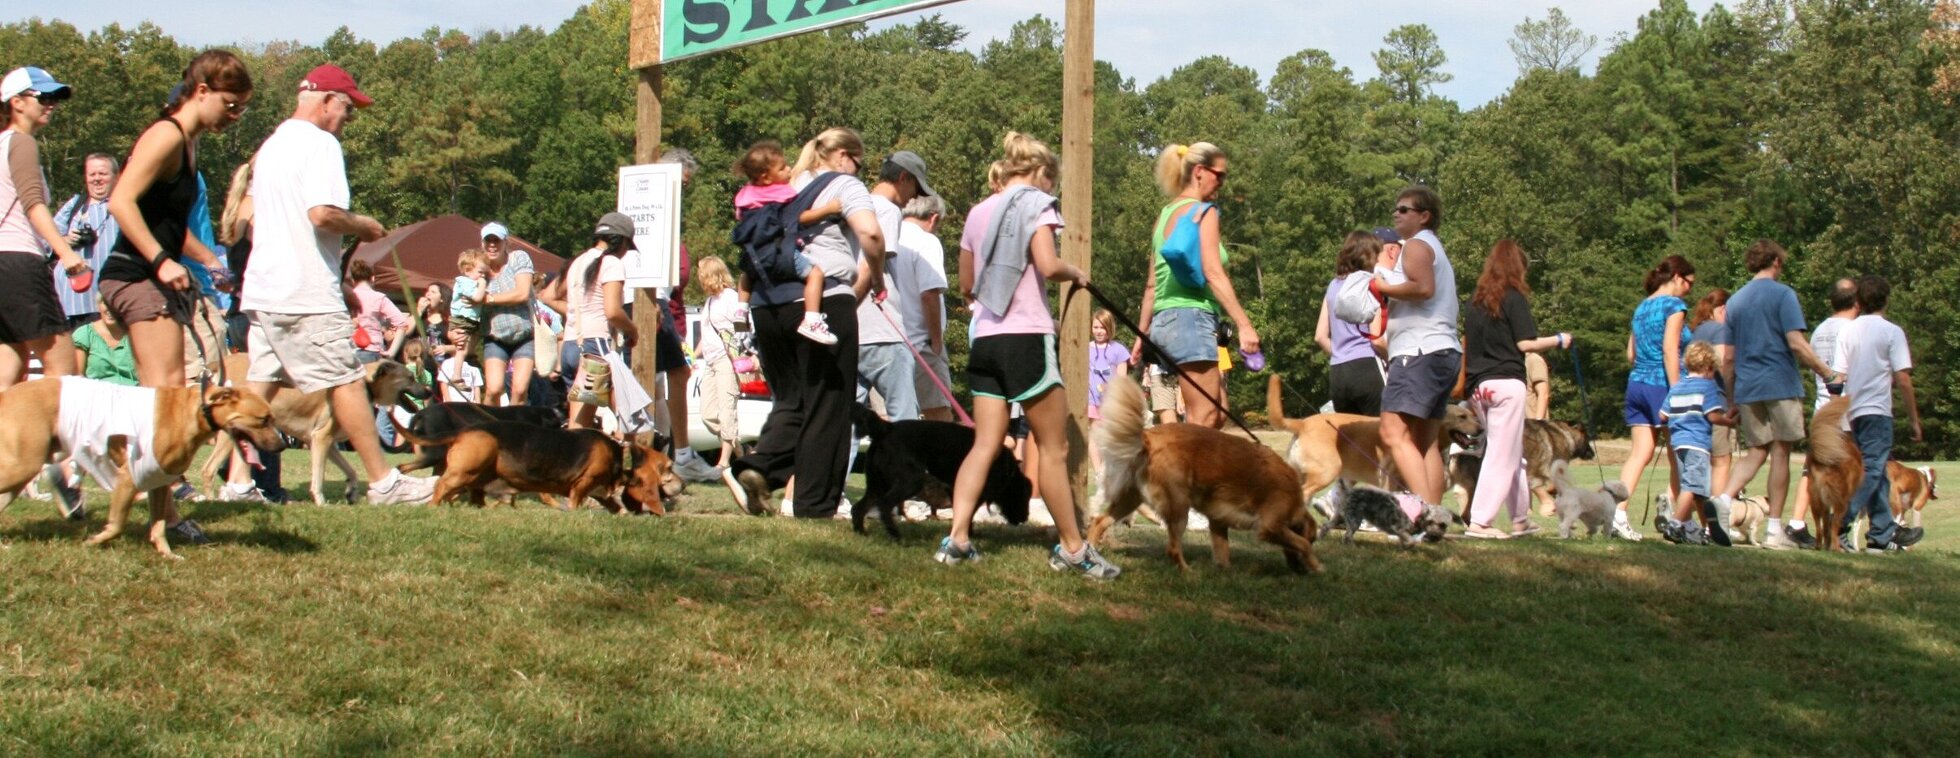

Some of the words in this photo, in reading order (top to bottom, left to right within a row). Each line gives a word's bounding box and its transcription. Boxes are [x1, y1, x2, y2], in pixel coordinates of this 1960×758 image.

[682, 0, 877, 47] ST
[630, 213, 655, 222] TARTS
[635, 227, 650, 235] ERE
